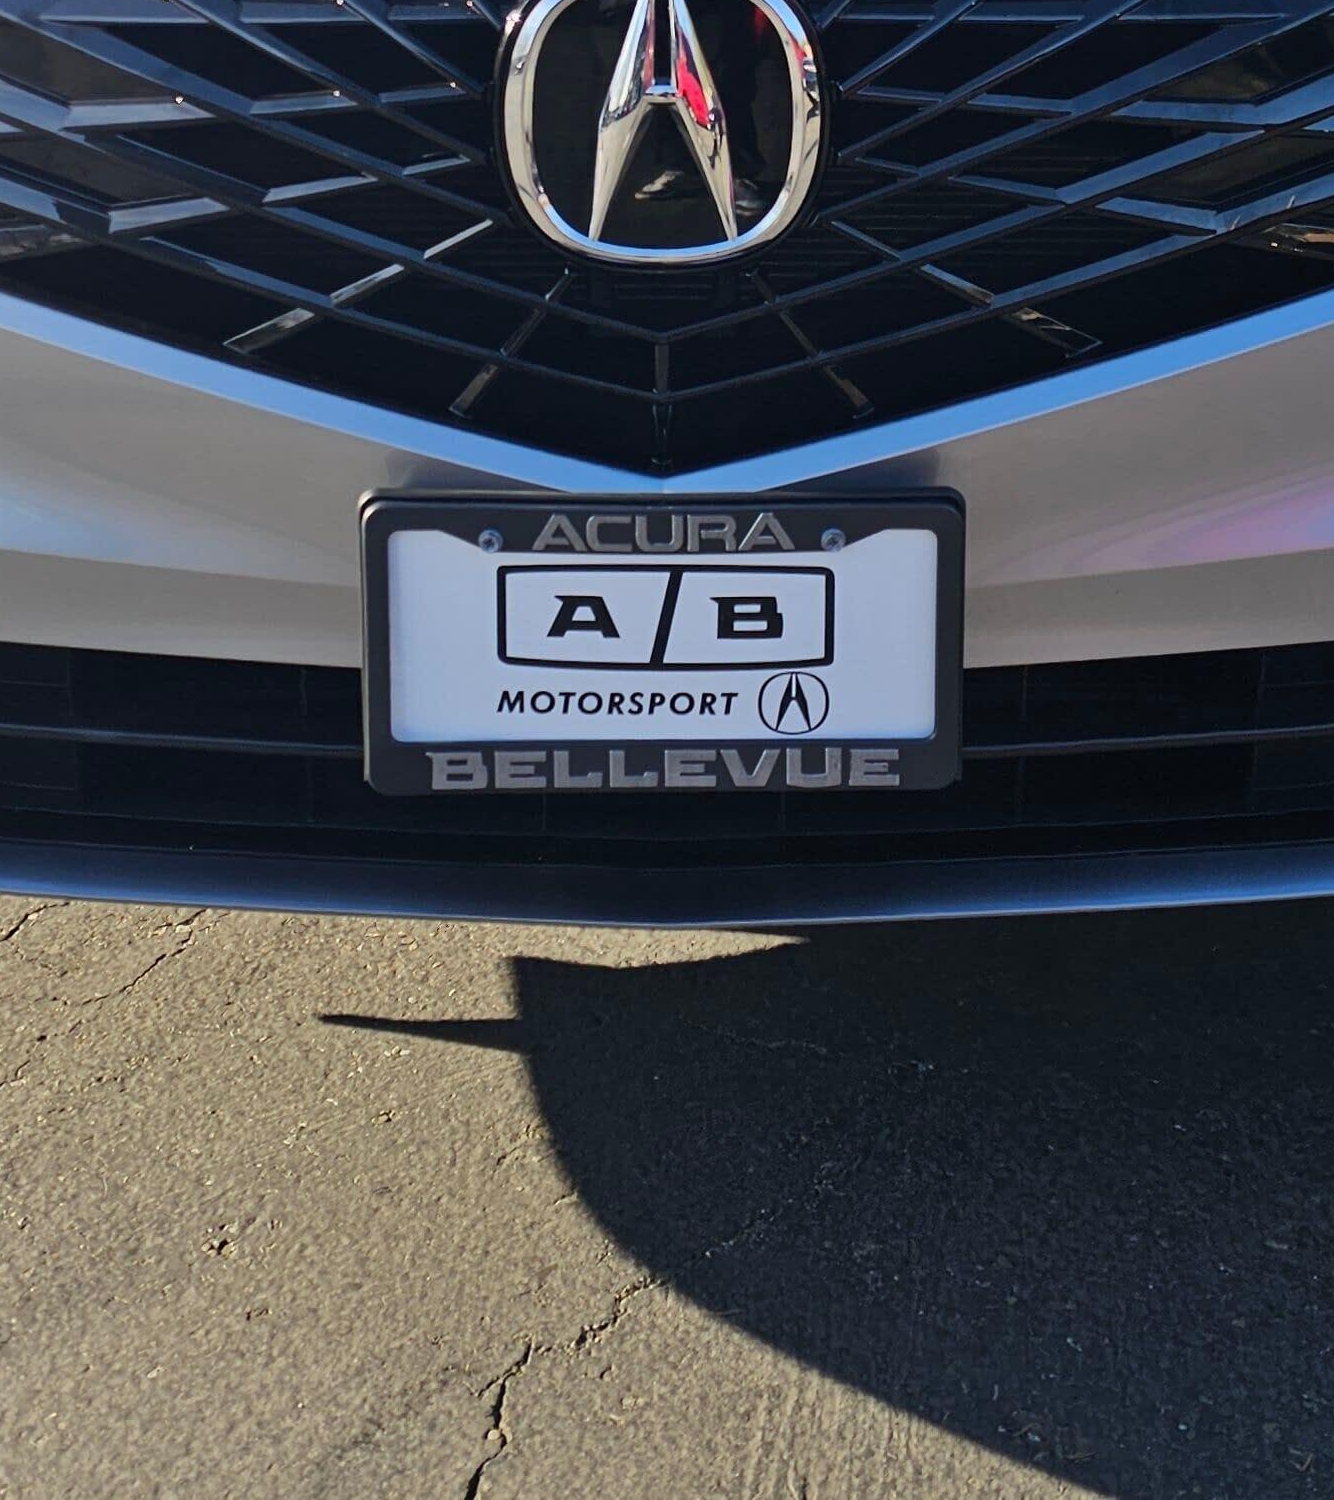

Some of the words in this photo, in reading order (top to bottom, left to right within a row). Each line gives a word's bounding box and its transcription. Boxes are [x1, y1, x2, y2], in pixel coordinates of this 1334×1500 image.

[531, 512, 796, 553] ACURA
[496, 690, 739, 716] MOTORSPORT
[425, 747, 900, 791] BELLEVUE
